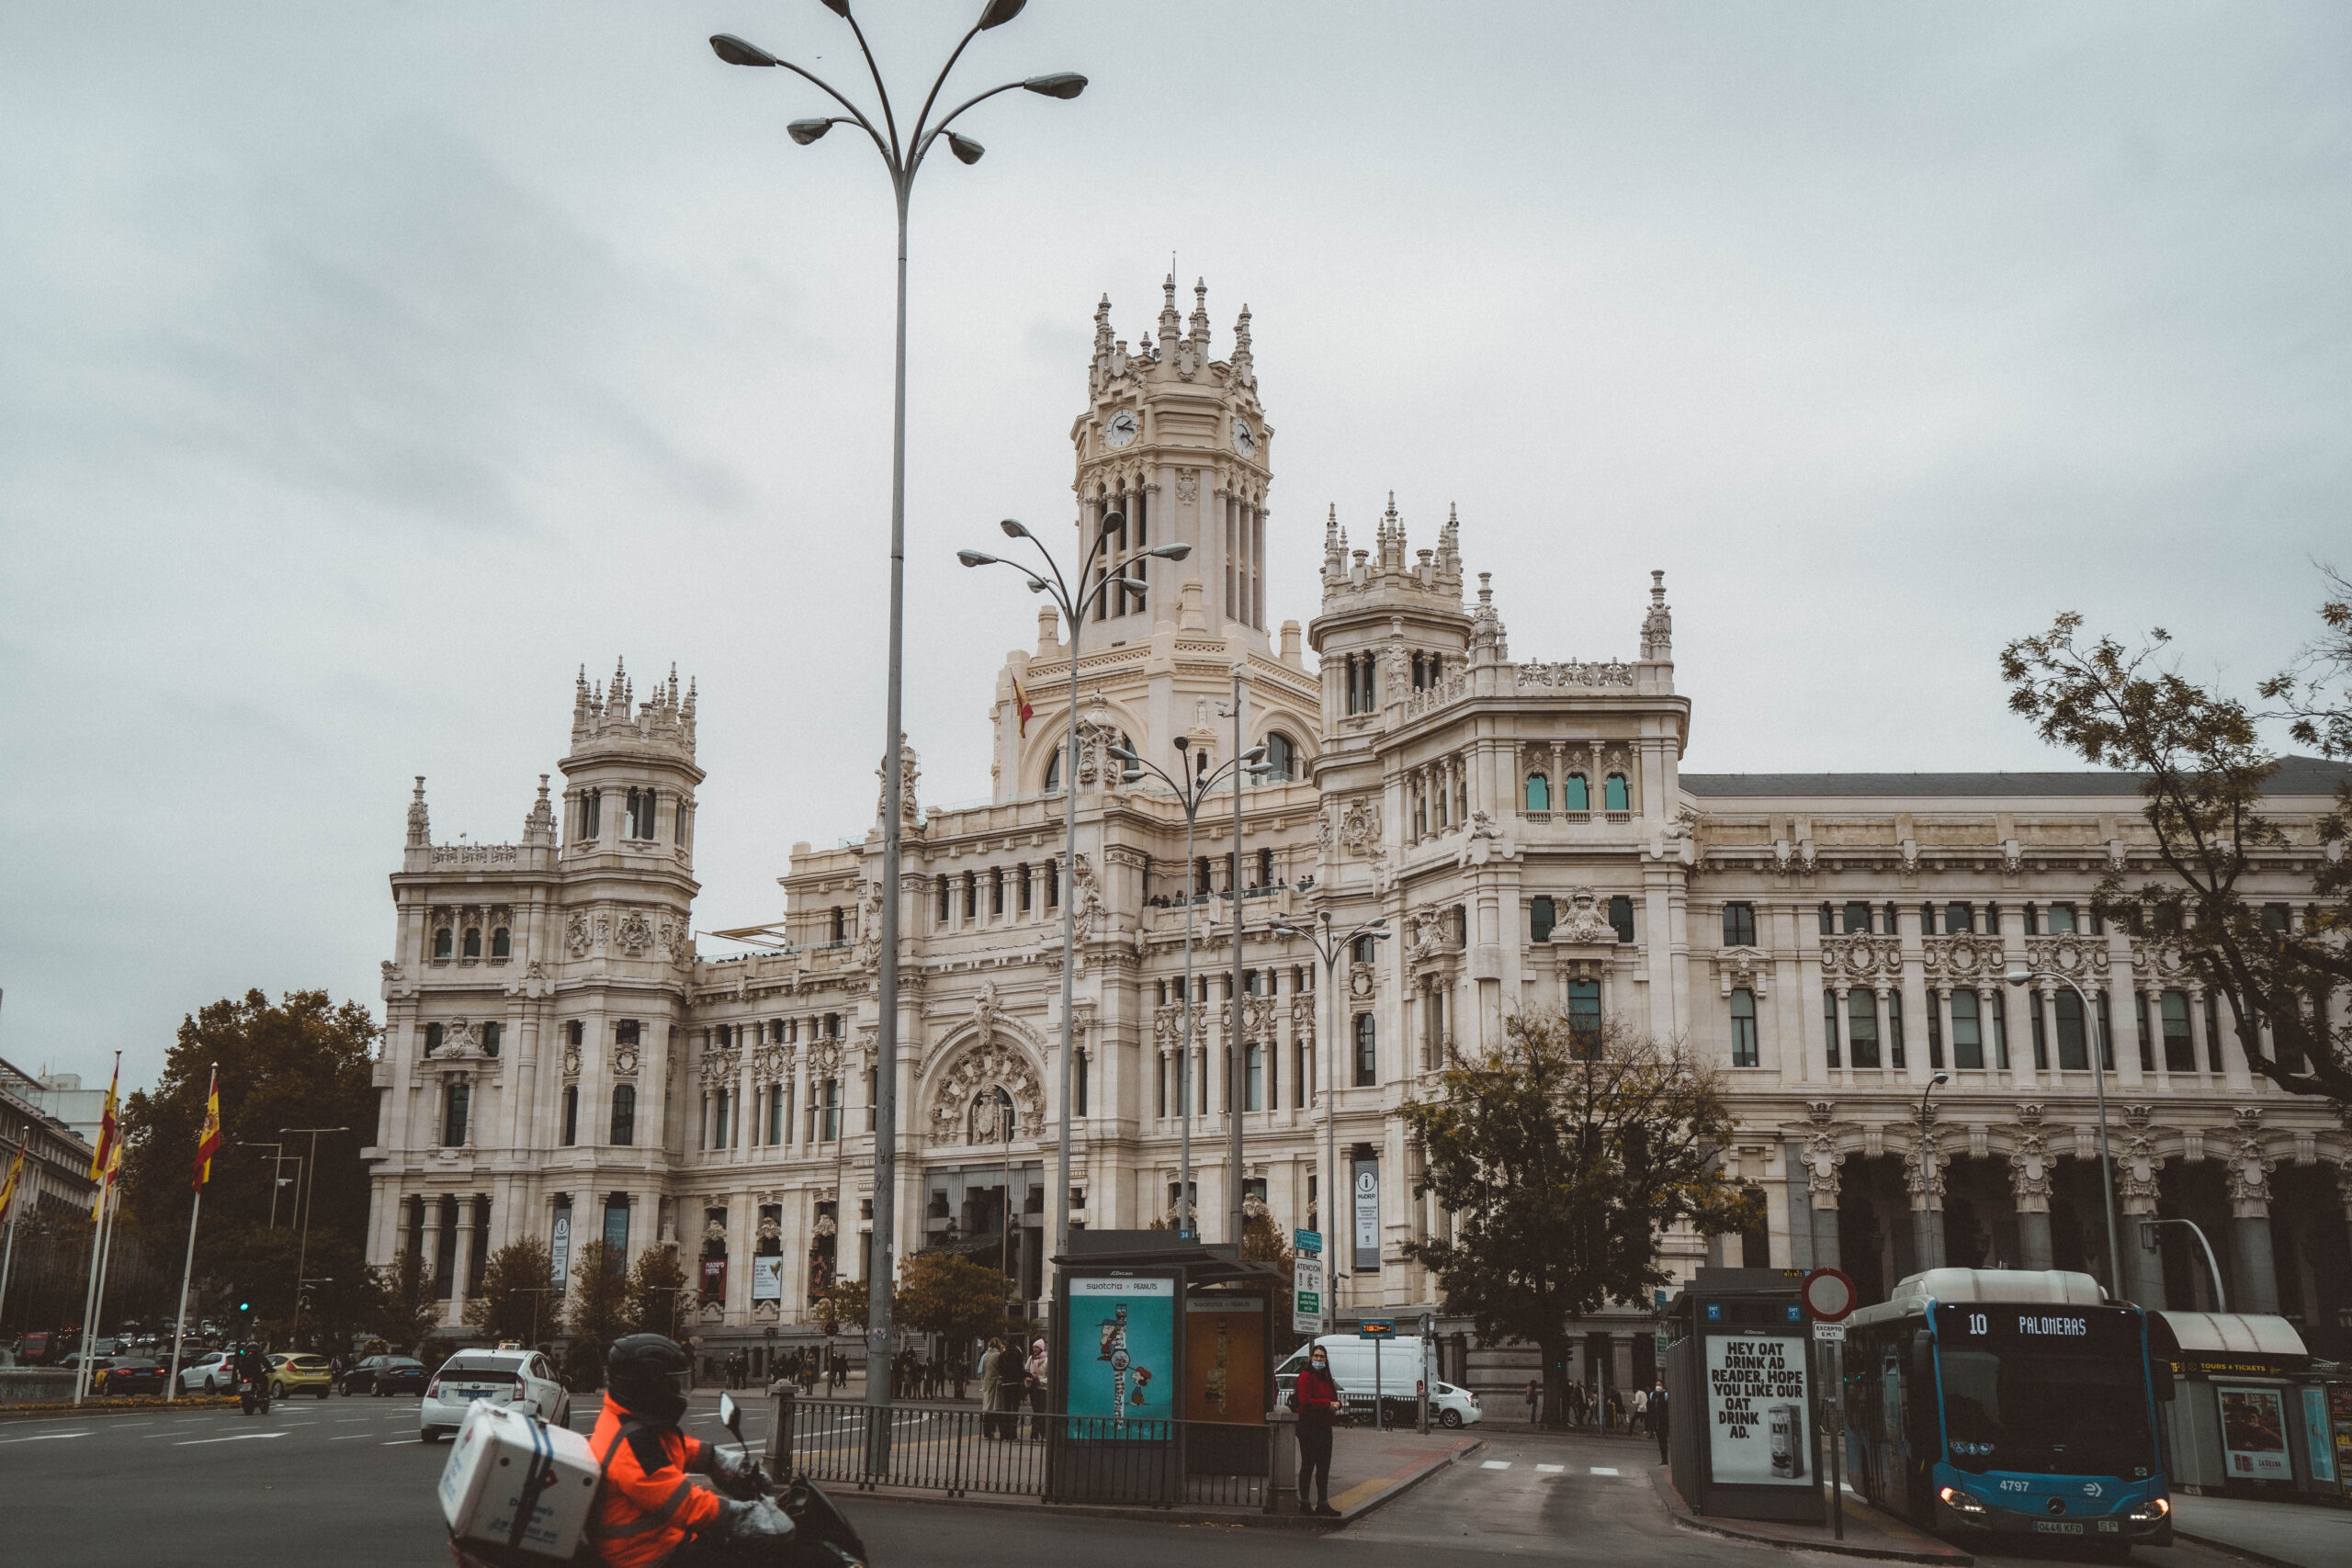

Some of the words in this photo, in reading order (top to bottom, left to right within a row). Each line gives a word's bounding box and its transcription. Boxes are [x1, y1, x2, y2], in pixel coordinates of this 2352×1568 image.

[1296, 1263, 1321, 1272] ATENCIÓN
[1969, 1314, 1987, 1335] 10
[2018, 1316, 2086, 1336] PALOMERAS
[1727, 1342, 1755, 1355] HEY
[1758, 1343, 1784, 1356] OAT
[1725, 1356, 1766, 1369] DRINK
[1768, 1357, 1784, 1370] AD
[2200, 1362, 2226, 1371] TOURS
[1712, 1370, 1765, 1384] READER,
[1767, 1371, 1804, 1384] HOPE
[1713, 1383, 1741, 1396] YOU
[1745, 1383, 1773, 1397] LIKE
[1777, 1385, 1803, 1398] OUR
[1725, 1398, 1750, 1410] OAT
[1719, 1411, 1759, 1425] DRINK
[1730, 1426, 1750, 1438] AD.
[1999, 1480, 2030, 1493] 4797
[2039, 1522, 2062, 1532] 0446
